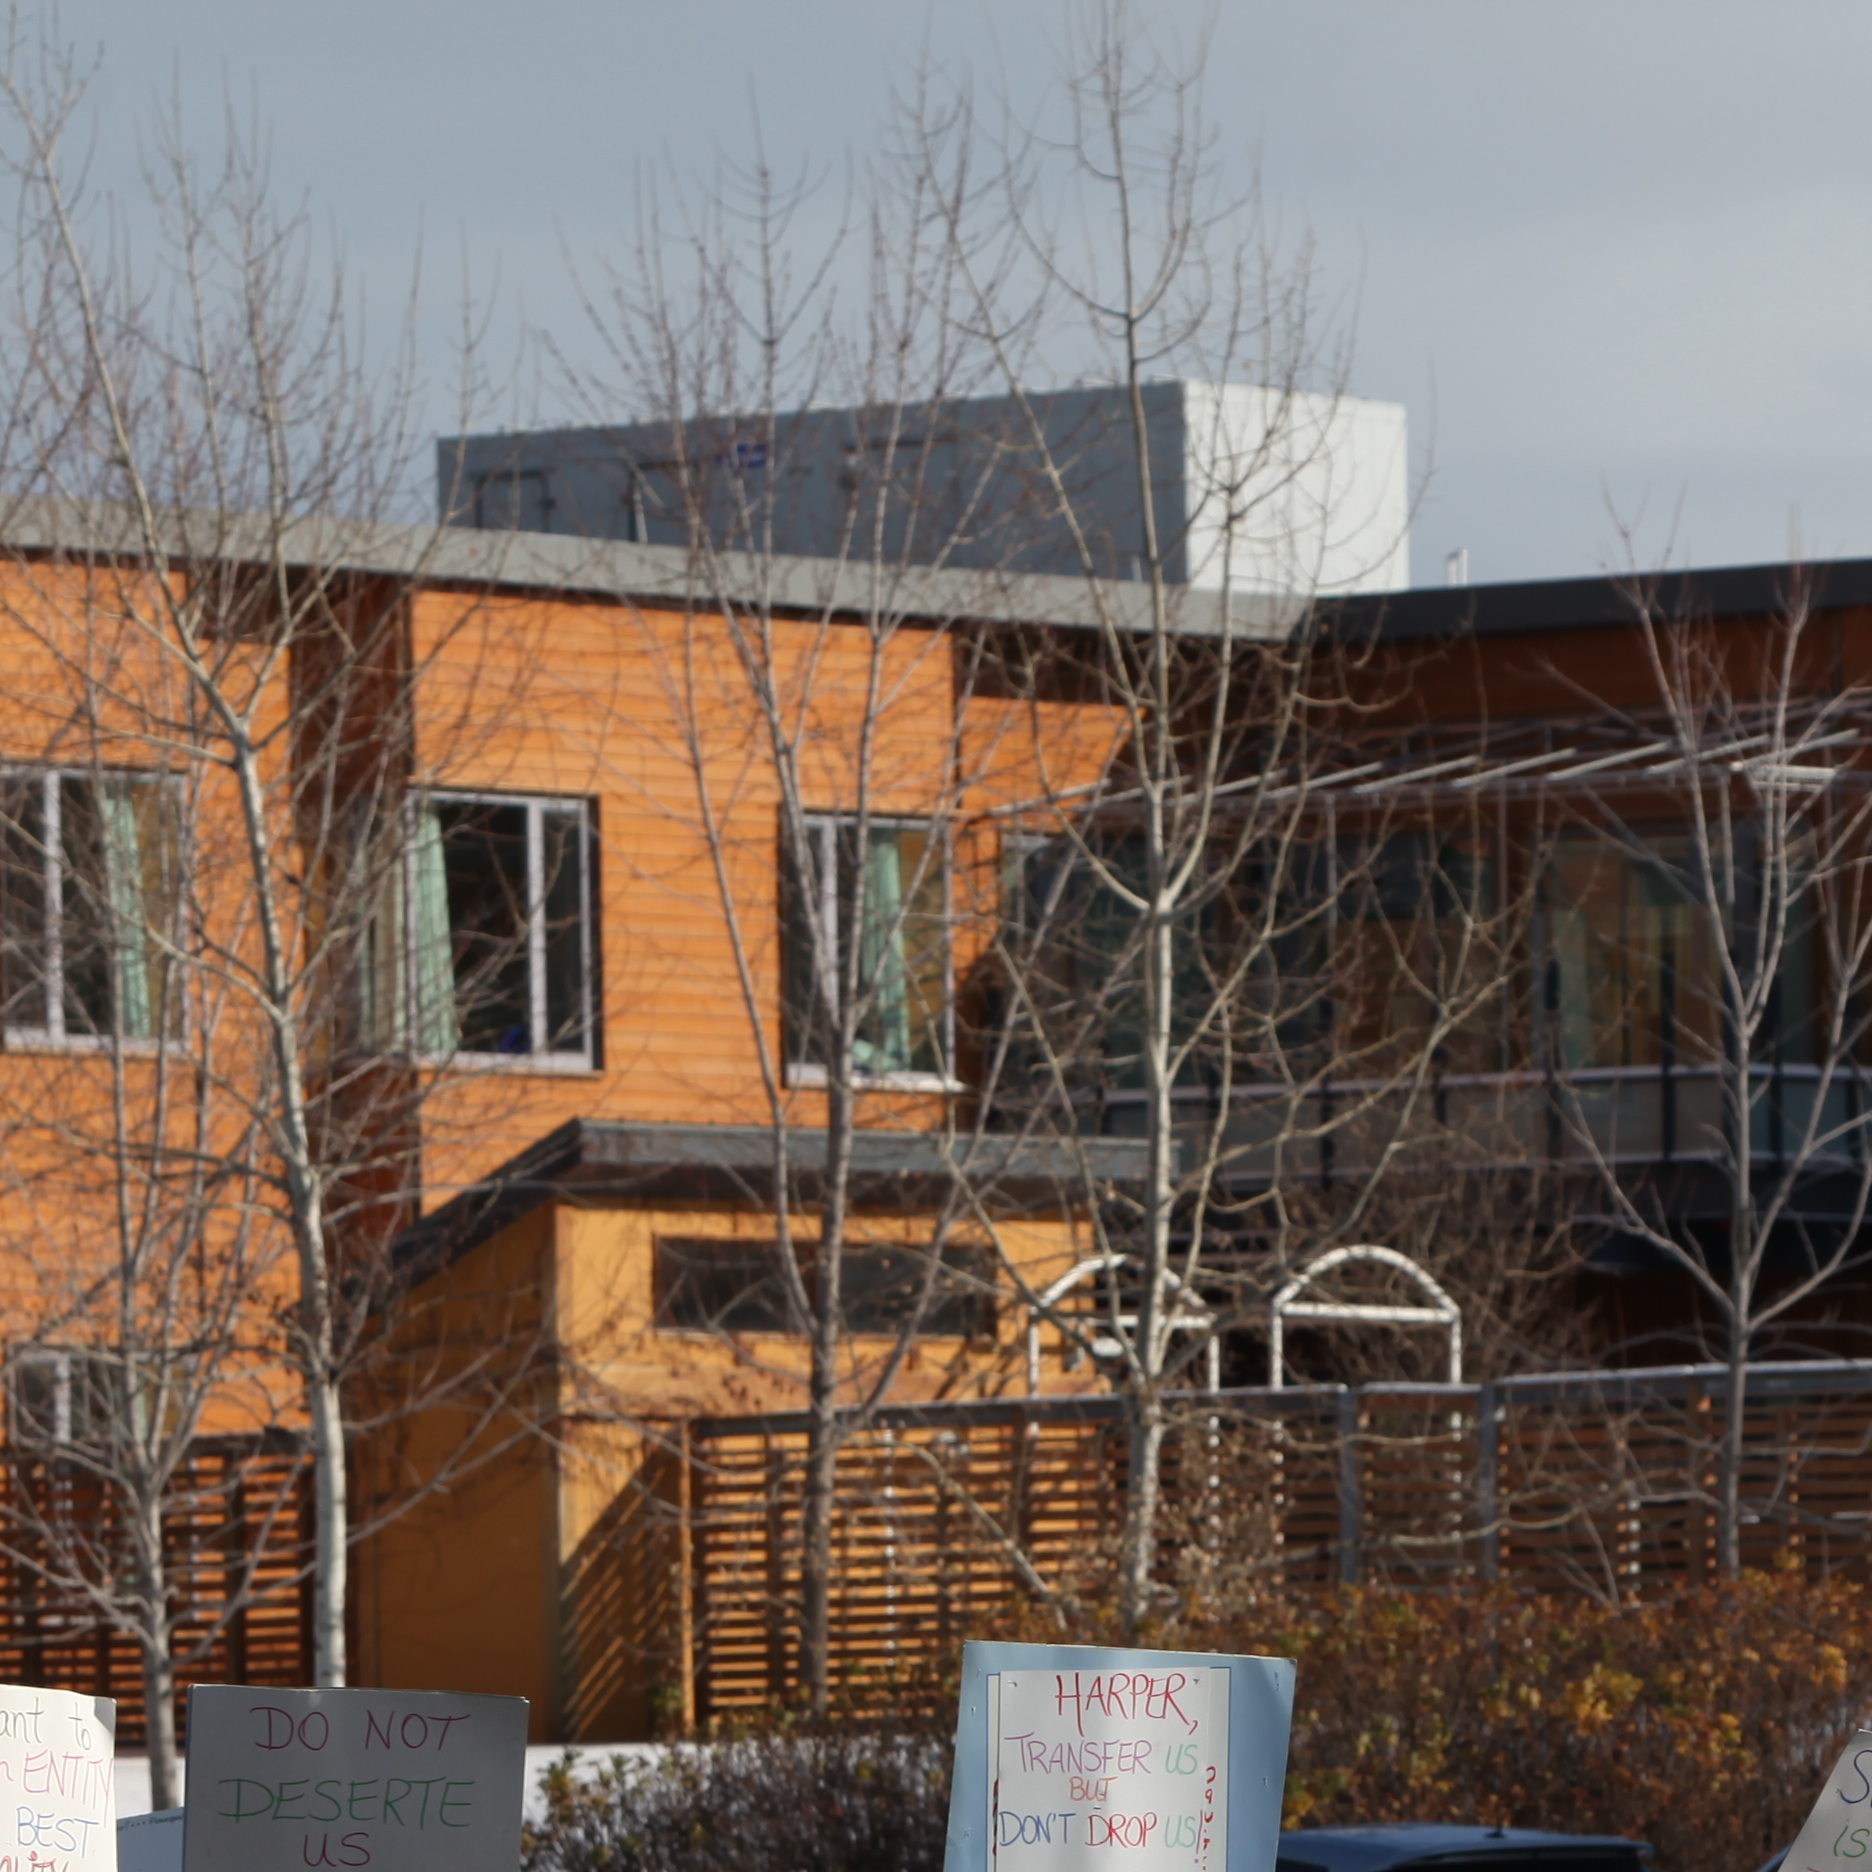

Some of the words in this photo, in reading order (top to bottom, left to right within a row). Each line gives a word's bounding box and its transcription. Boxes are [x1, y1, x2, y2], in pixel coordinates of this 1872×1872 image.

[68, 1702, 92, 1751] to
[250, 1707, 329, 1751] DO
[365, 1710, 470, 1751] NOT
[1005, 1731, 1152, 1775] TRANSFER
[1166, 1744, 1197, 1775] US
[23, 1750, 113, 1828] ENTITY
[218, 1776, 475, 1830] DESERTE
[1070, 1776, 1118, 1802] BUT
[16, 1806, 100, 1858] BEST
[303, 1832, 371, 1867] US
[1000, 1811, 1076, 1847] DON'T
[1085, 1812, 1158, 1848] DROP
